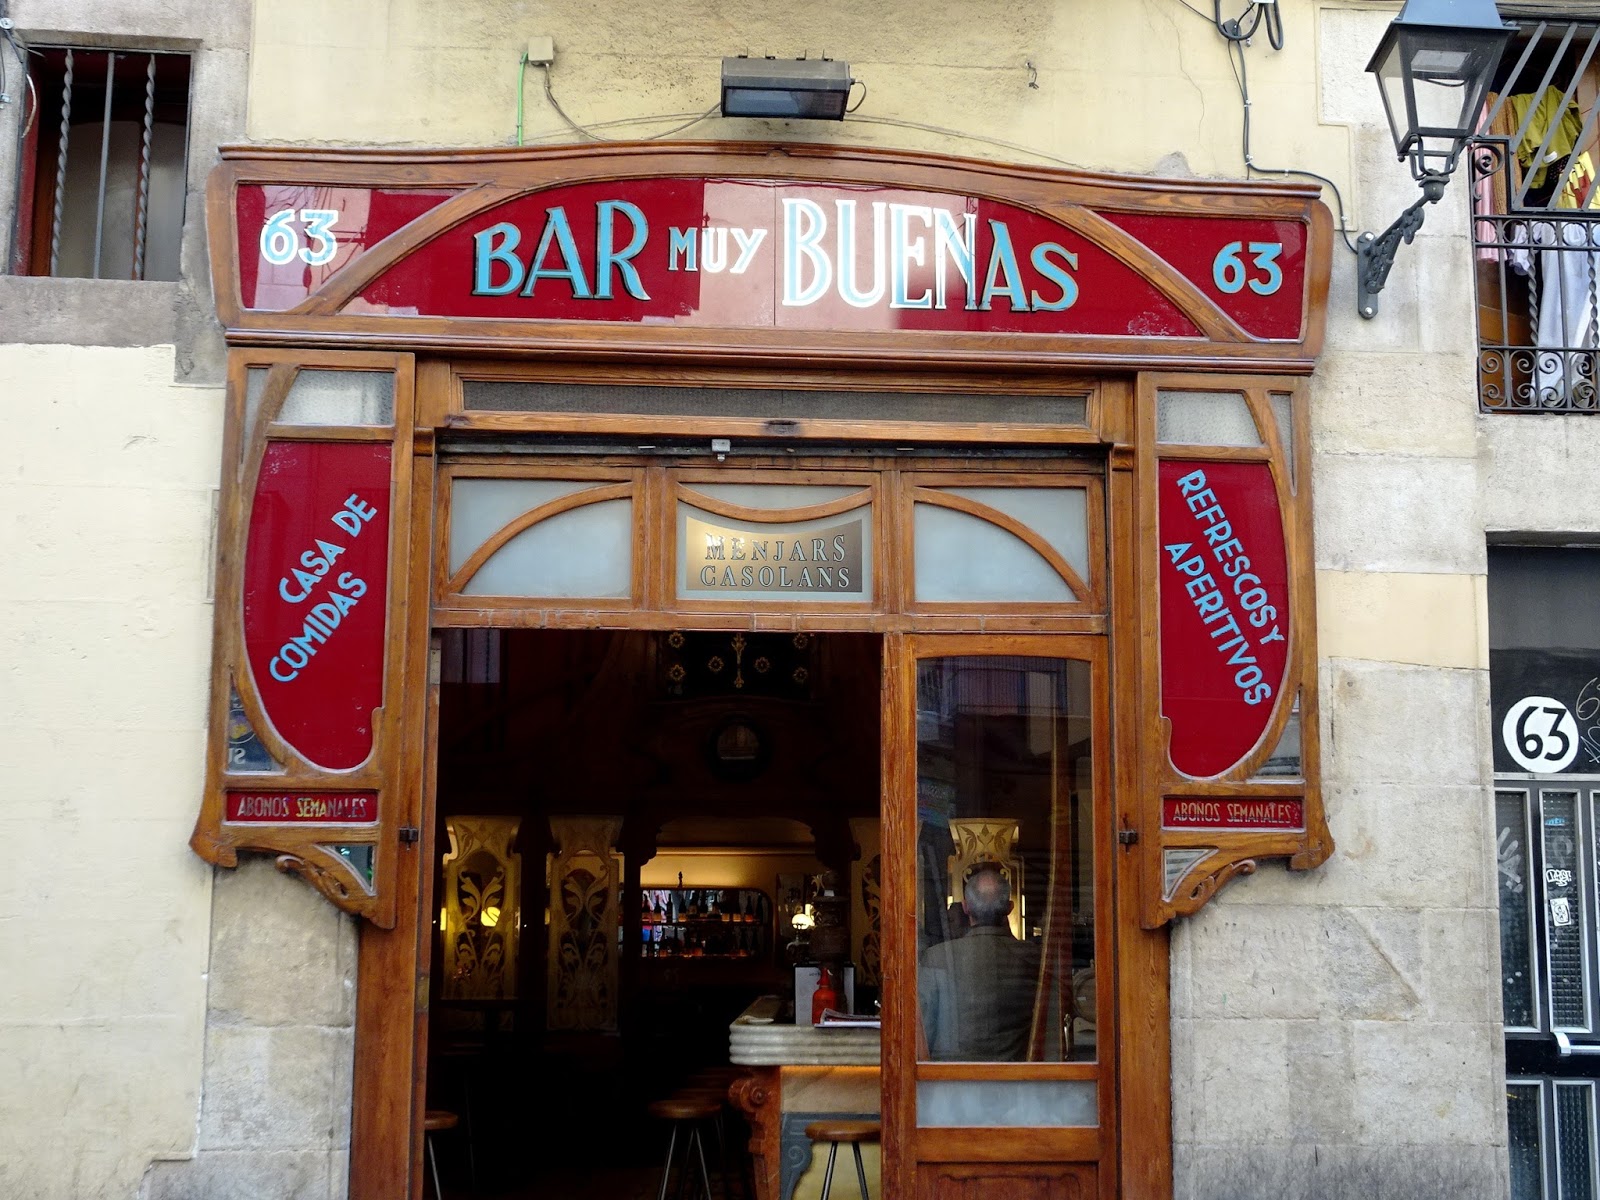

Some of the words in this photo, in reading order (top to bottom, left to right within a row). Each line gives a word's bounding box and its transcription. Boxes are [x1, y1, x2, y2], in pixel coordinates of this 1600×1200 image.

[260, 209, 339, 266] 63
[472, 199, 652, 301] BAR
[668, 226, 768, 274] MUY
[782, 198, 1079, 312] BUENAS
[1212, 240, 1283, 296] 63
[278, 538, 347, 604] CASA
[330, 493, 378, 538] DE
[700, 565, 851, 588] CASOLANS
[704, 533, 846, 563] MENJARS
[1176, 469, 1278, 628] REFRESCOS
[1259, 624, 1285, 645] Y
[269, 571, 368, 683] COMIDAS
[1164, 542, 1273, 706] APERITIVOS
[1515, 705, 1570, 762] 63
[237, 797, 290, 818] ABONOS
[296, 797, 367, 818] SEMANALES
[1172, 803, 1221, 823] ABONOS
[1226, 803, 1292, 824] SEMANALES
